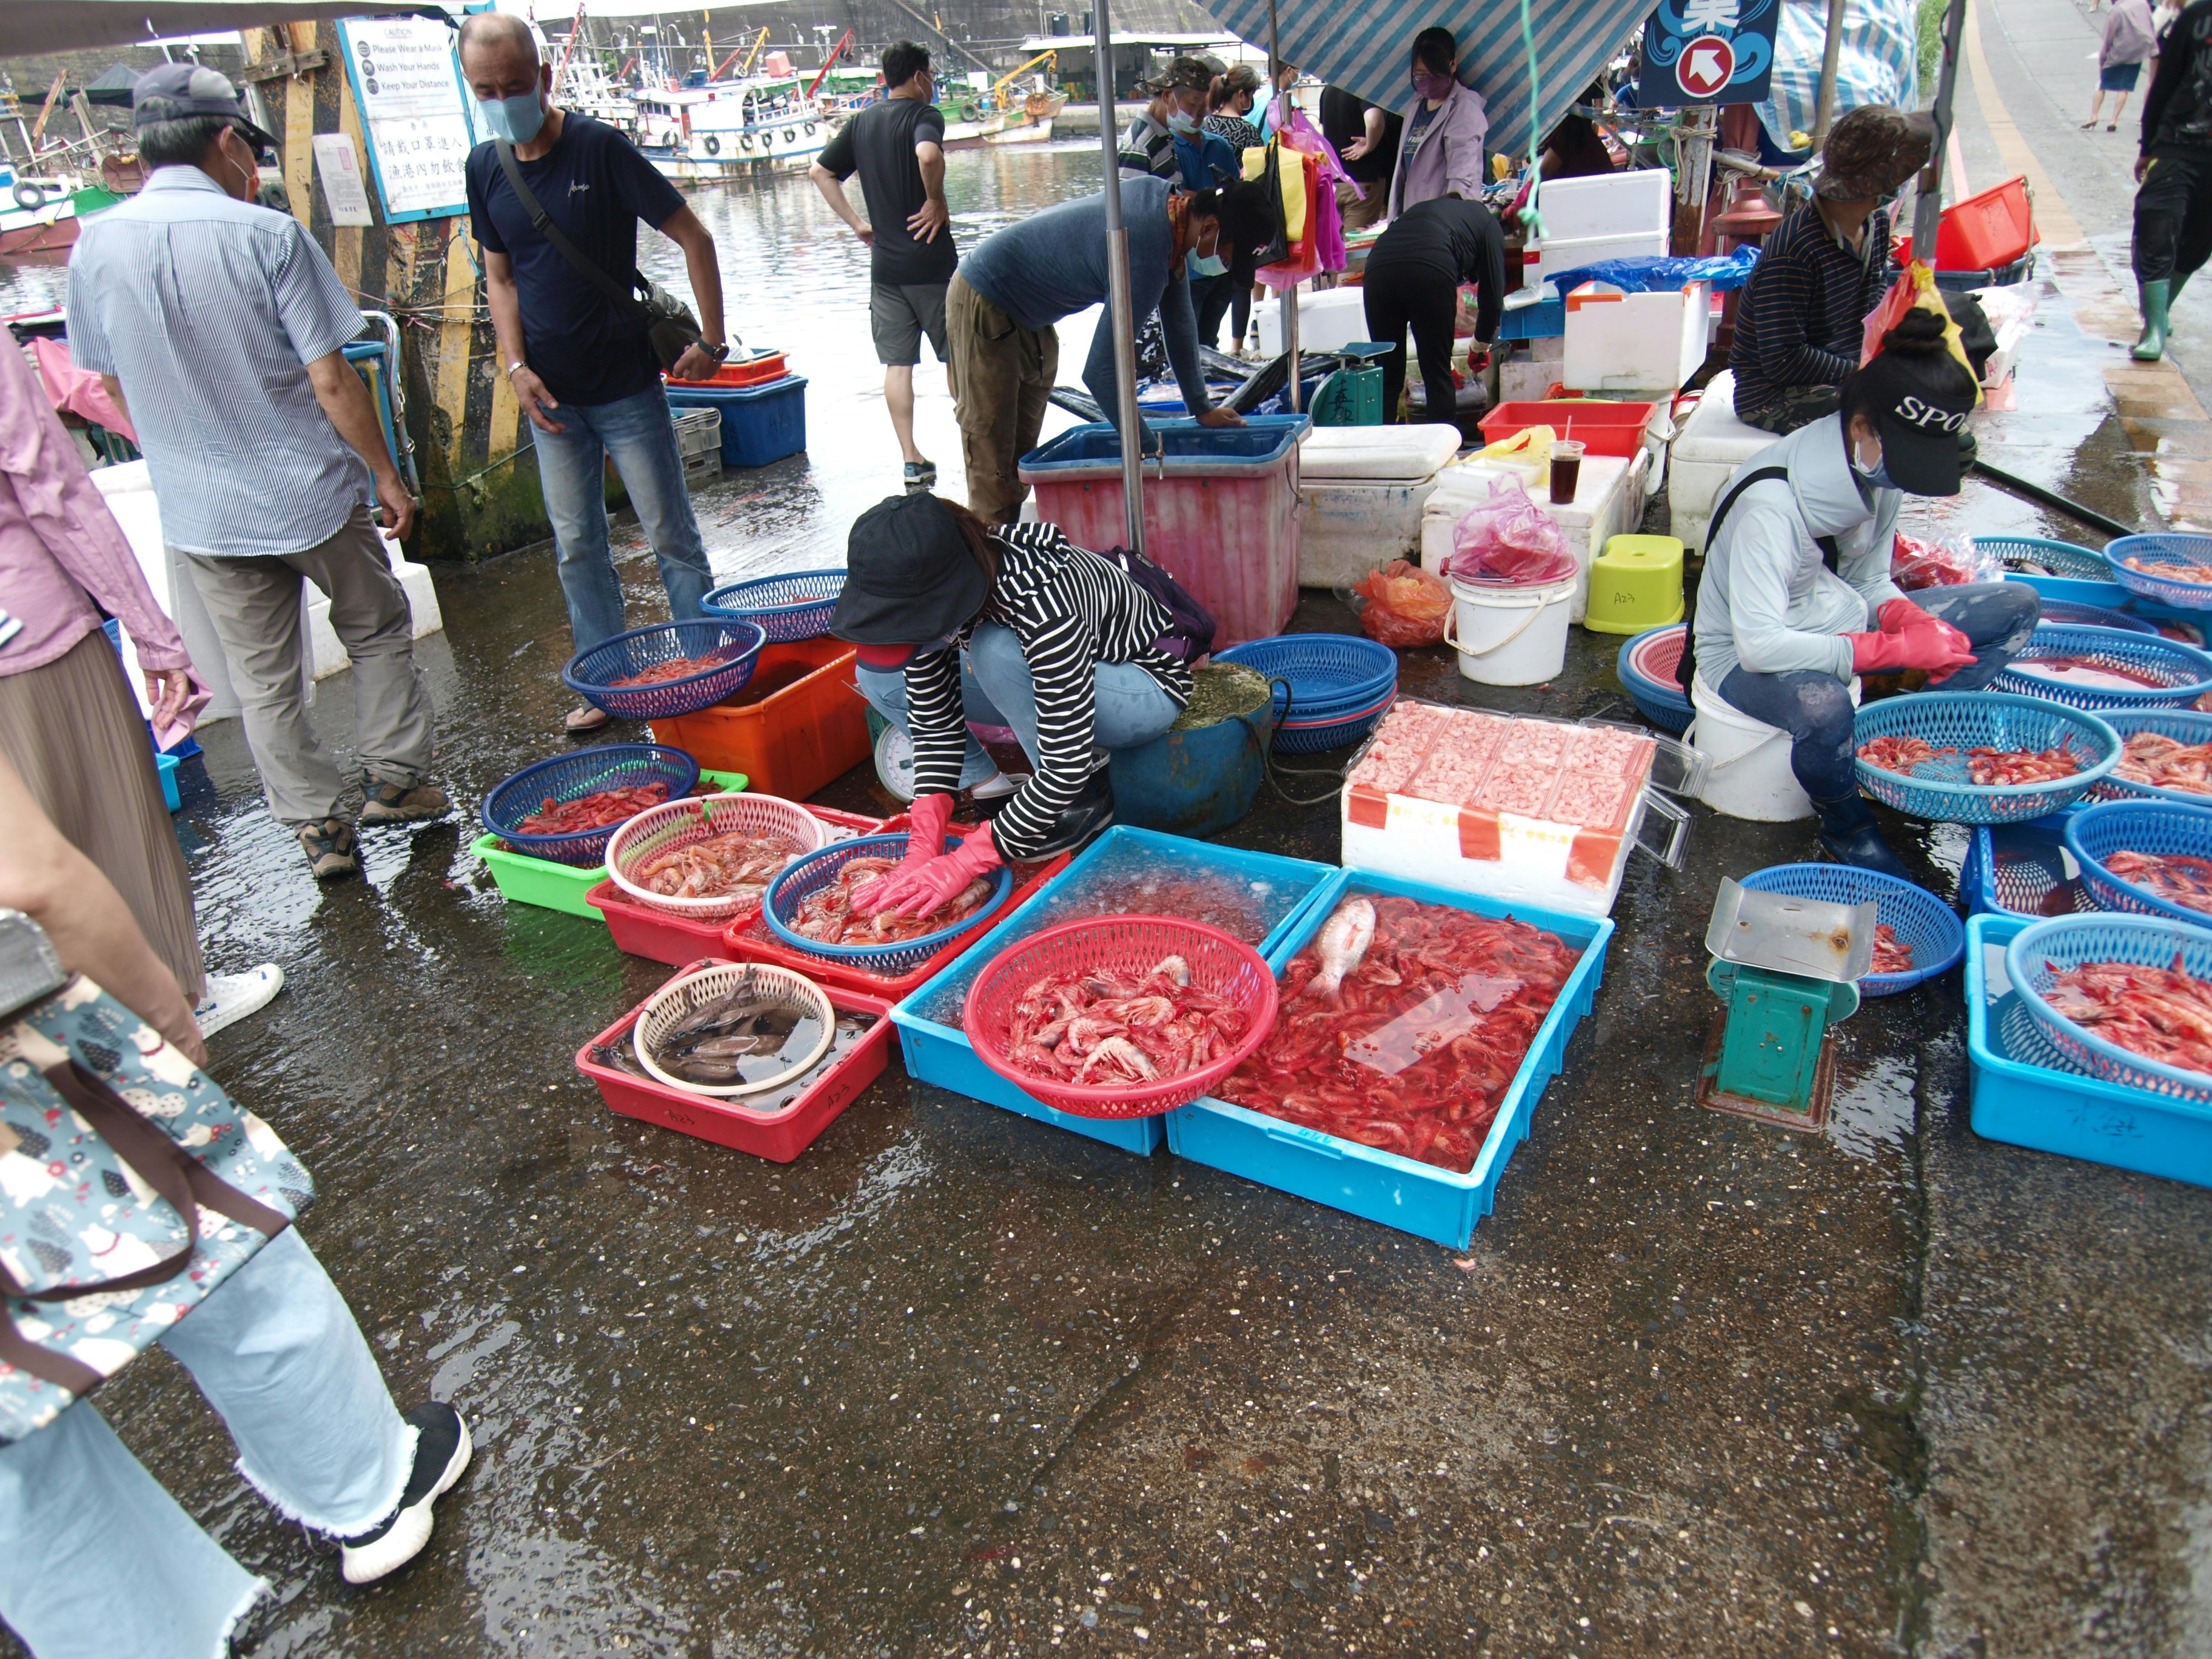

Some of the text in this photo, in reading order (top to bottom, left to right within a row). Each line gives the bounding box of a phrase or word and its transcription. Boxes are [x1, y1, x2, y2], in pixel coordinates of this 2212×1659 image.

[372, 45, 397, 53] Please
[397, 44, 417, 53] Wear
[377, 64, 398, 72] Wash
[417, 62, 440, 71] Hands
[381, 79, 449, 91] Keep Your Distance
[380, 136, 462, 156] 請戴口罩進入
[1614, 592, 1635, 605] A23
